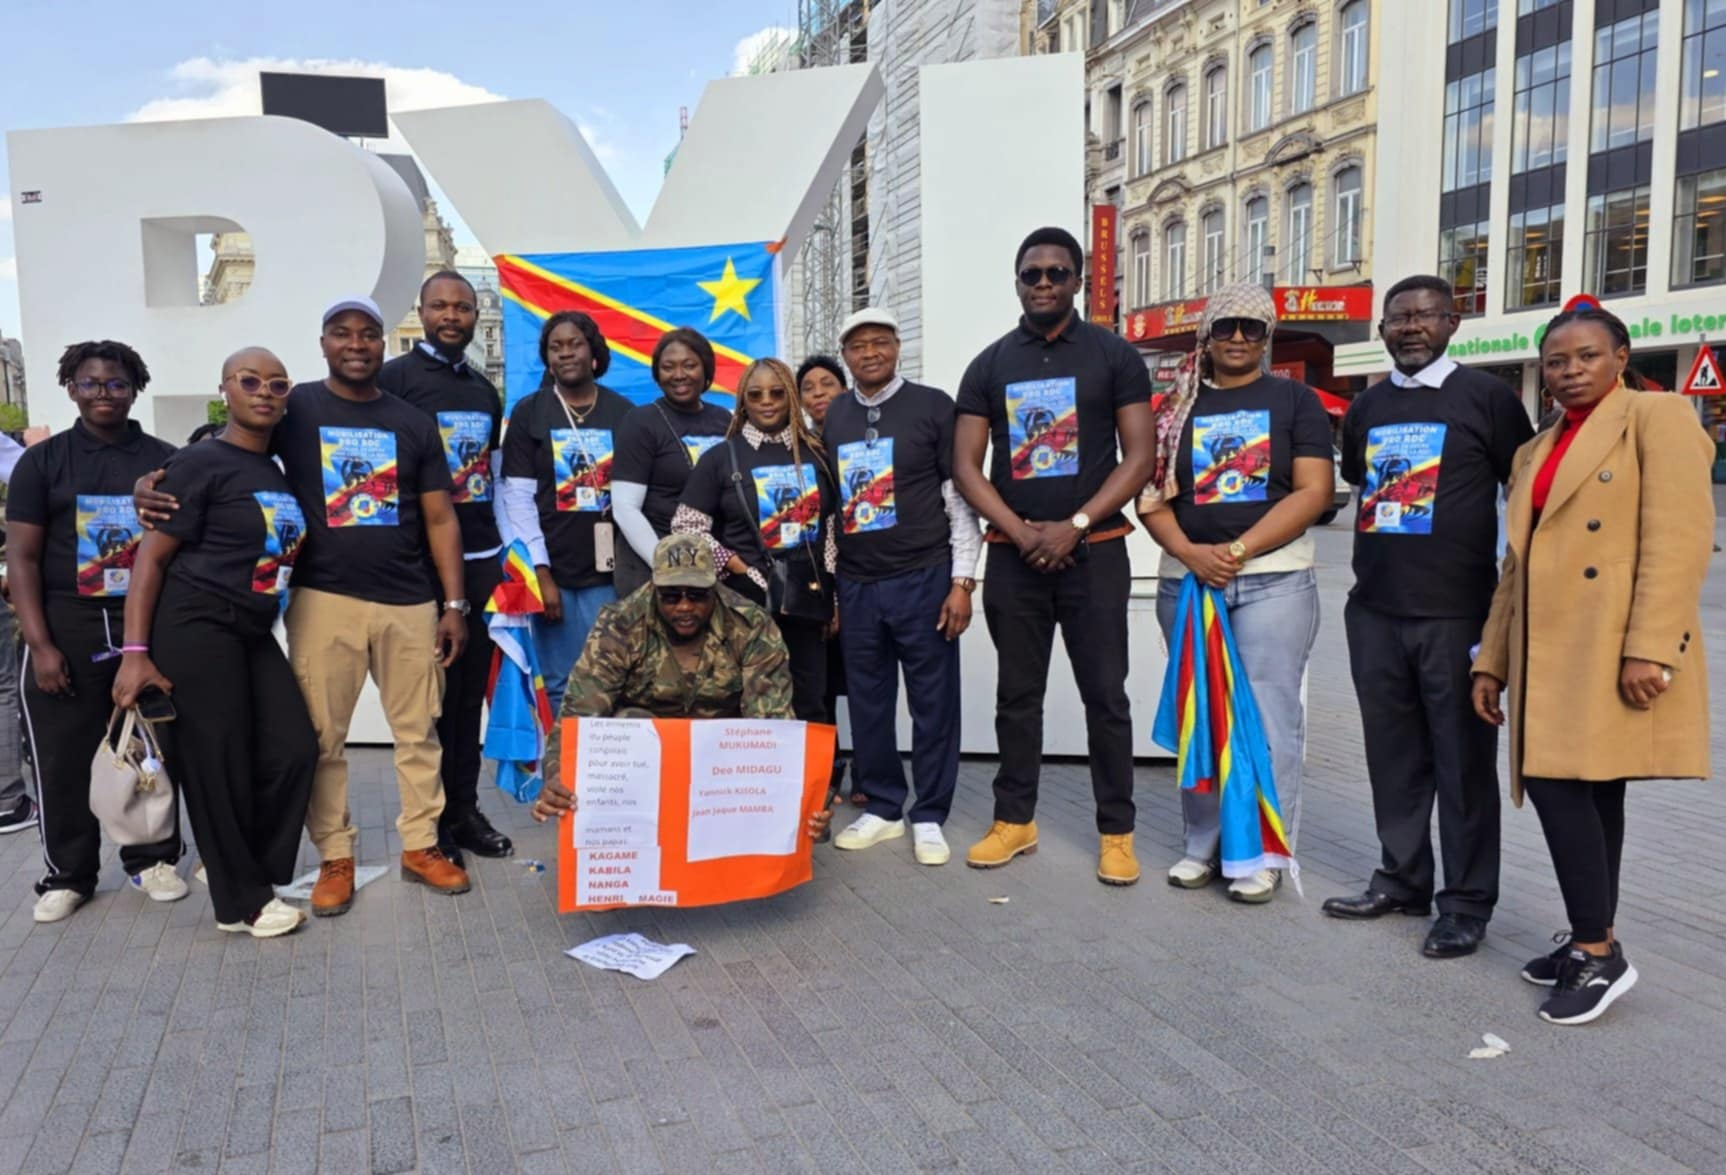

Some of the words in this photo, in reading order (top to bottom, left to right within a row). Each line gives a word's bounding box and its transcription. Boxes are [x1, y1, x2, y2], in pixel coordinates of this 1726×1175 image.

[1099, 217, 1109, 309] BRUSSELS
[1447, 332, 1529, 356] nationale
[1404, 434, 1425, 443] RDC
[602, 733, 631, 743] peuple
[719, 740, 777, 750] MUKUMADI
[588, 760, 608, 769] pour
[736, 765, 782, 775] MIDAGU
[739, 805, 774, 814] MAMBA
[623, 825, 632, 833] et
[589, 851, 638, 861] KAGAME
[588, 865, 632, 875] KABILA
[588, 880, 629, 889] NANGA
[588, 894, 624, 903] HENRI
